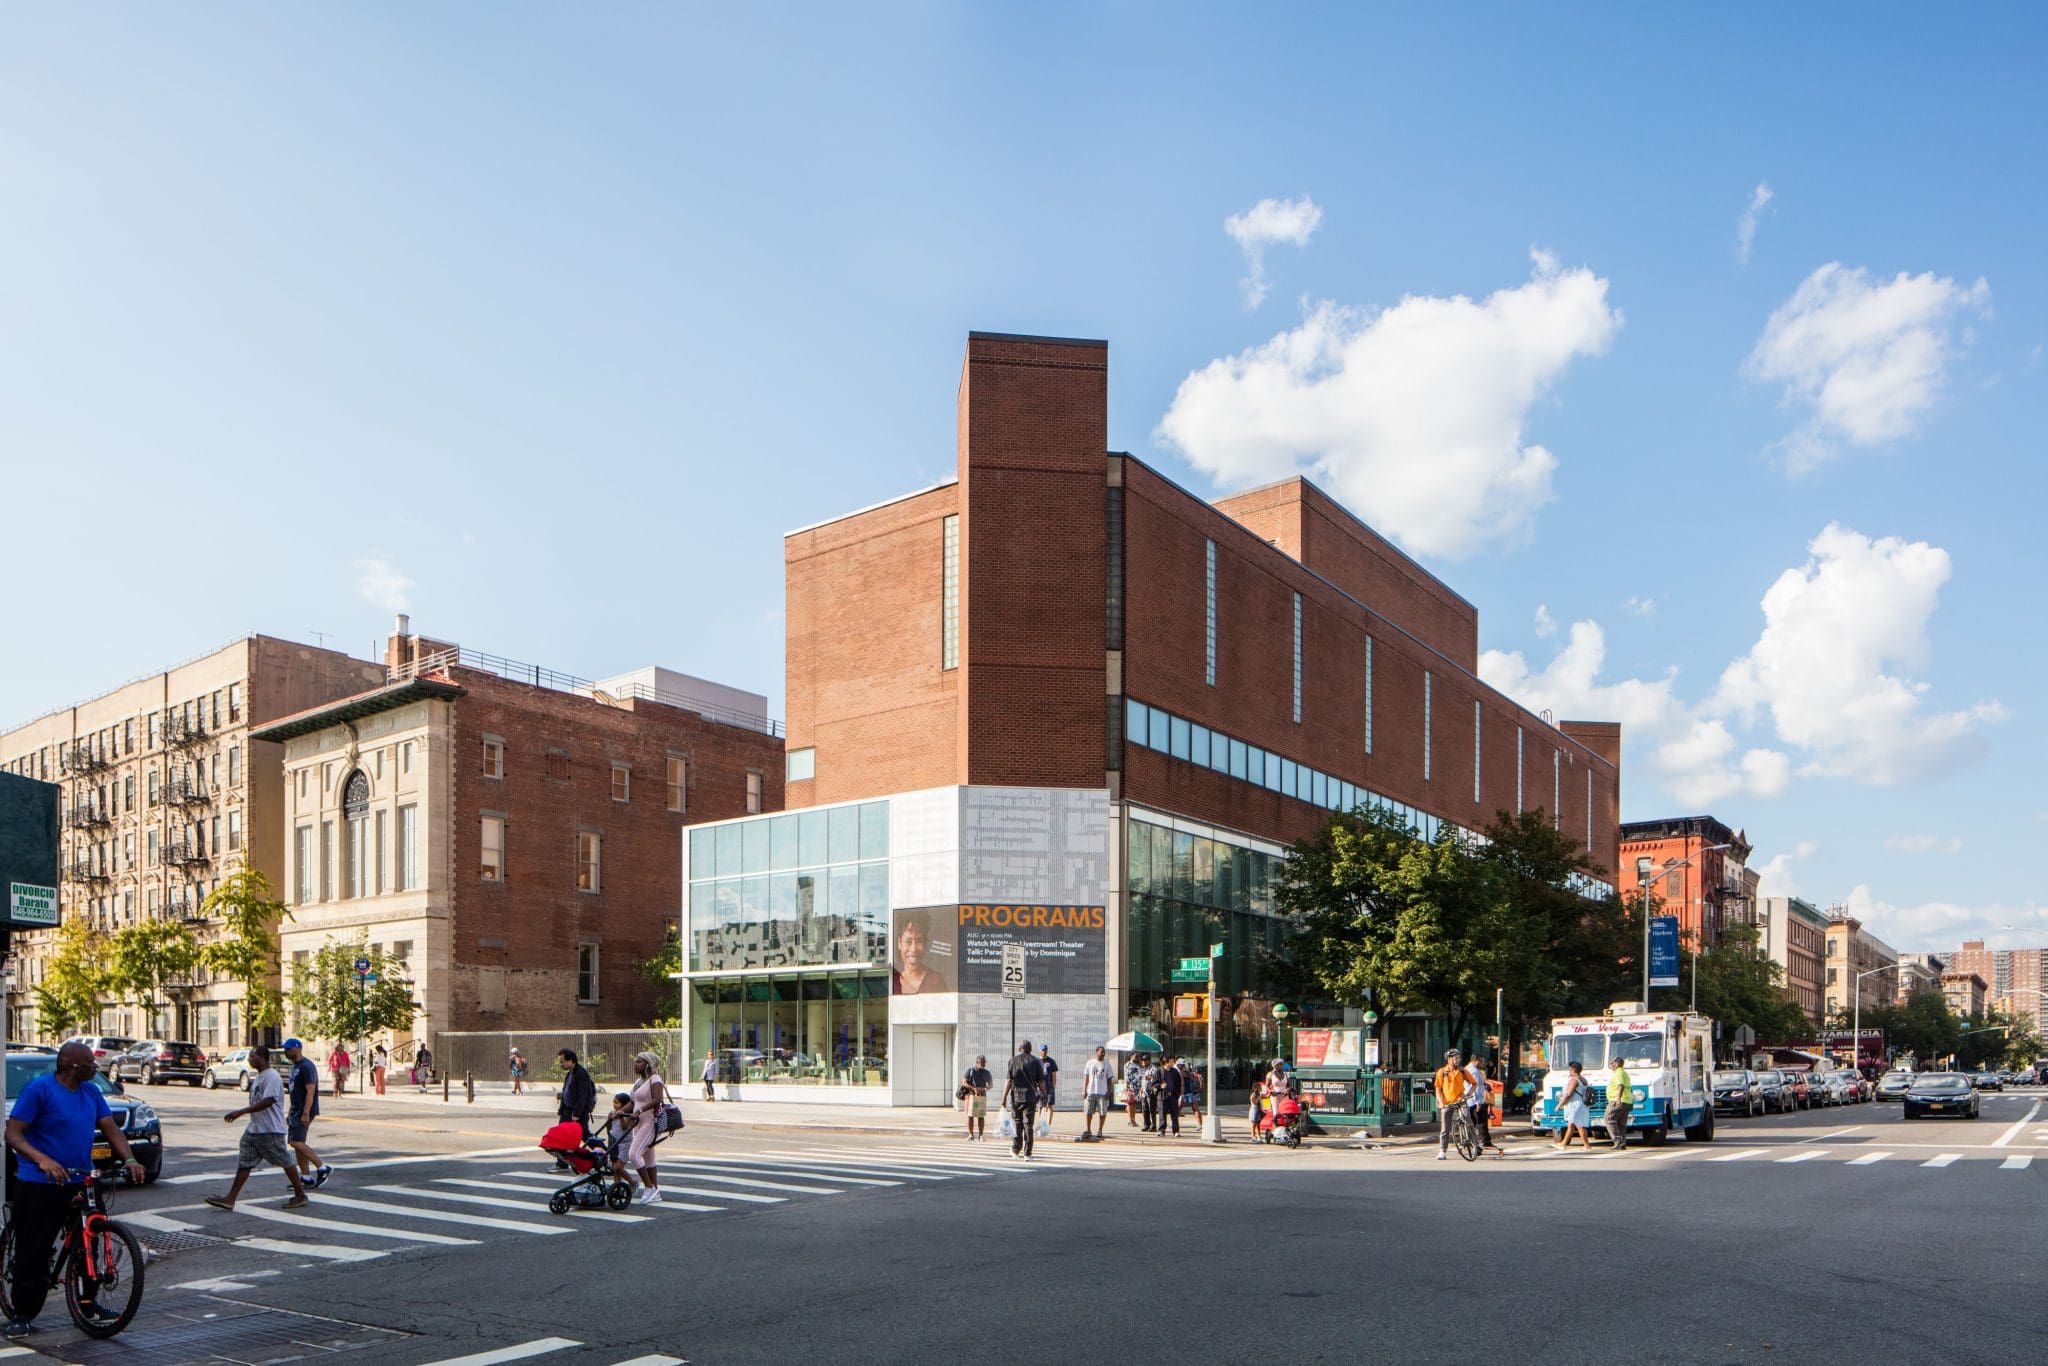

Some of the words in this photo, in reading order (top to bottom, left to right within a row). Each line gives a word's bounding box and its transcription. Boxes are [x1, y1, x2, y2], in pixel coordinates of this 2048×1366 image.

[12, 884, 55, 899] DIVORCIO
[19, 896, 49, 909] Barato
[959, 904, 1104, 928] PROGRAMS
[1059, 940, 1085, 948] Theater
[1030, 949, 1039, 957] by
[1040, 950, 1076, 958] Dominique
[966, 957, 1001, 965] Morisseau
[1182, 959, 1188, 969] W
[1192, 959, 1202, 969] 135
[1005, 966, 1023, 982] 25
[1597, 1024, 1619, 1033] Very
[1322, 1081, 1345, 1089] Station
